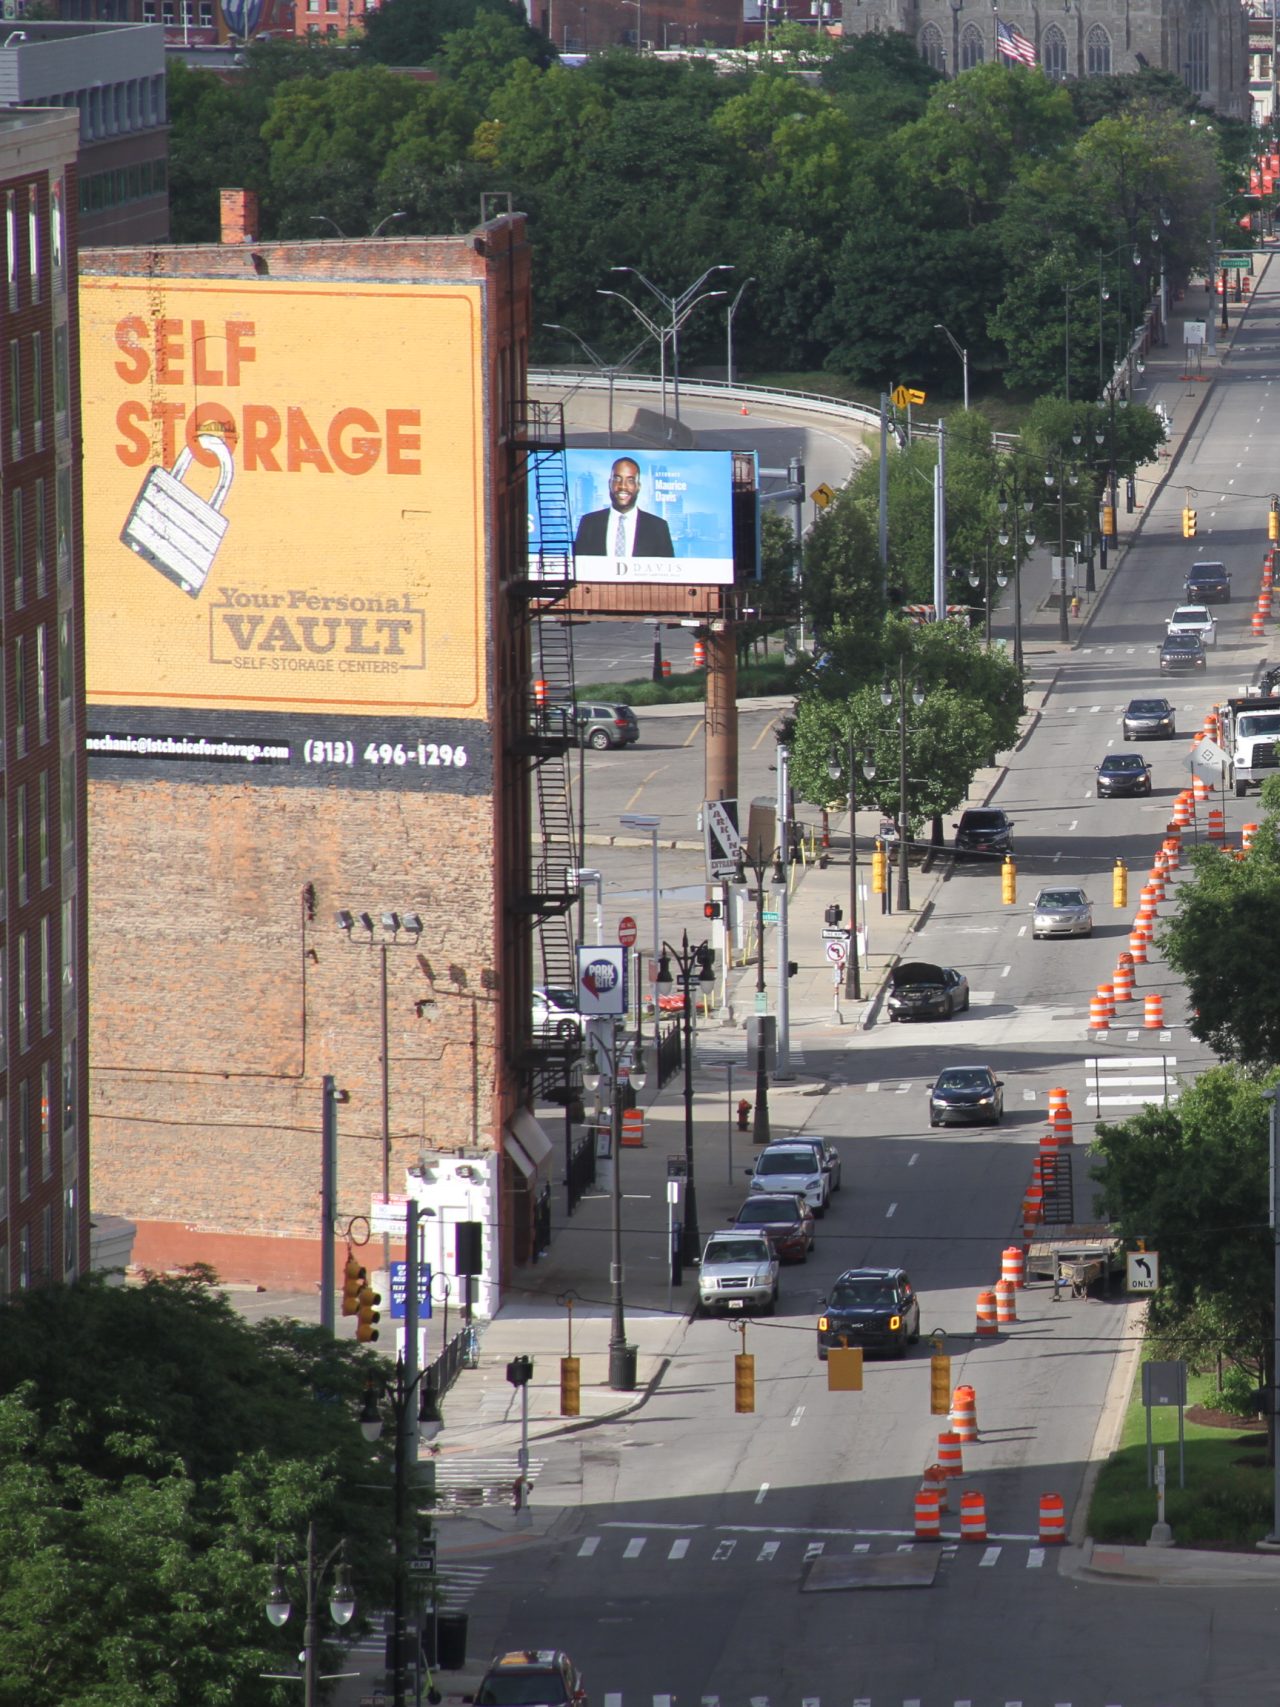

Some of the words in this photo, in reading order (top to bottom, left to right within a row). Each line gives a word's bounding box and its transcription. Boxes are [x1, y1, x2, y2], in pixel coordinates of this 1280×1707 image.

[114, 315, 256, 387] SELF
[115, 399, 421, 476] STORAGE
[655, 480, 687, 491] Maurice
[655, 491, 677, 503] Davis
[634, 563, 682, 573] DAVIS
[217, 586, 286, 609] Your
[287, 590, 413, 613] Personal
[222, 614, 413, 655] VAULT
[233, 656, 335, 672] SELF-STORAGE
[338, 660, 399, 674] CENTERS
[303, 739, 354, 765] (313)
[363, 743, 467, 767] 496-1296
[708, 803, 740, 858] PARKING
[589, 964, 615, 978] PARK
[1132, 1280, 1153, 1288] ONLY
